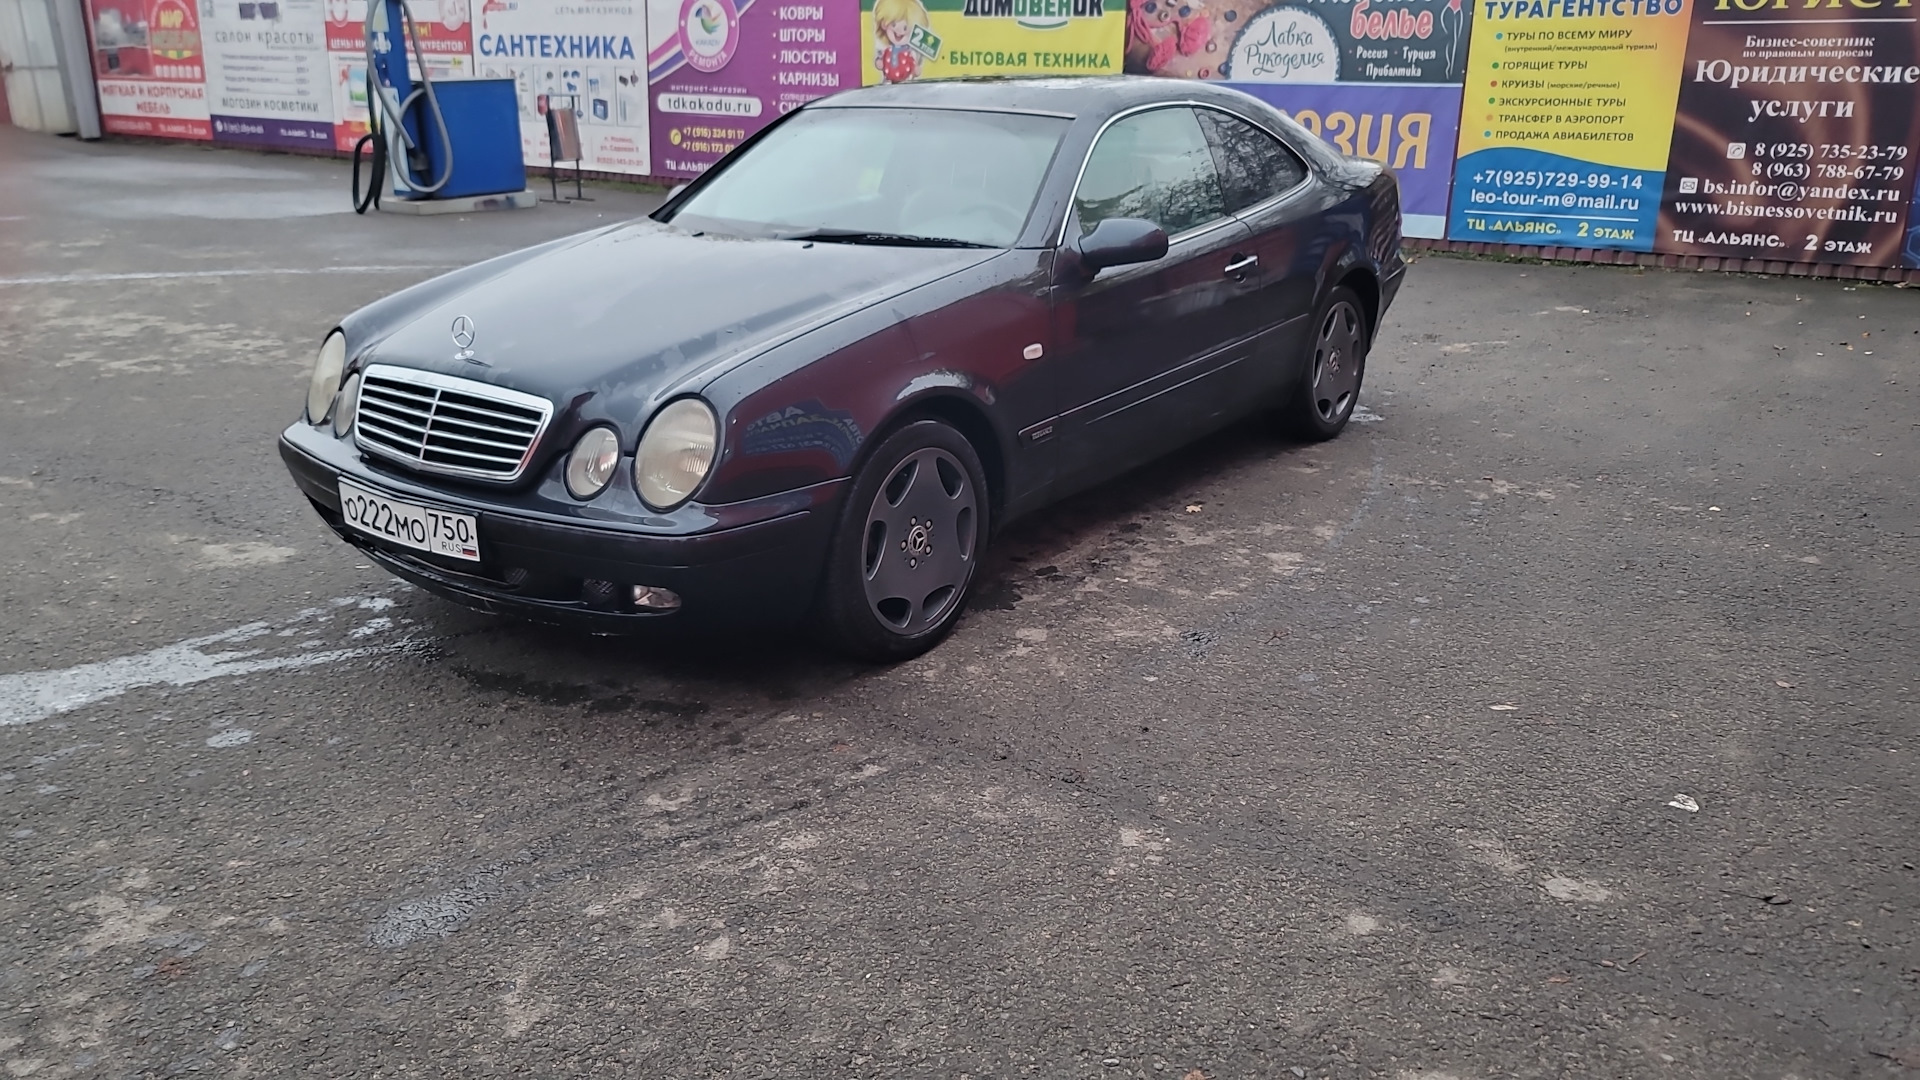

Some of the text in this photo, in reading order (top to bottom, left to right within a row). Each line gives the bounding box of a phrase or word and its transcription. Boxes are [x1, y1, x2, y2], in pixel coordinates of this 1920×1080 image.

[779, 6, 824, 21] КОВРЫ
[963, 0, 1104, 17] ДОМОВЕНОК
[1485, 0, 1684, 20] ТУРАГЕНТСТВО
[1350, 0, 1434, 41] белье
[215, 31, 315, 49] салон красоты
[779, 28, 825, 42] ШТОРЫ
[911, 27, 924, 47] 2
[1257, 21, 1314, 48] Лавка
[1506, 30, 1633, 41] ТУРЫ ПО ВСЕМУ МИРУ
[1745, 35, 1875, 48] Бизнес-советник
[479, 34, 636, 60] САНТЕХНИКА
[1356, 45, 1437, 64] Россия Турция
[1743, 50, 1874, 60] по правовым вопросам
[689, 50, 727, 68] РЕМОНТА
[779, 50, 837, 65] ЛЮСТРЫ
[950, 51, 1111, 69] БЫТОВАЯ ТЕХНИКА
[1244, 43, 1326, 78] Рукоделия
[1502, 61, 1588, 71] ГОРЯЩИЕ ТУРЫ
[779, 71, 840, 87] КАРНИЗЫ
[1365, 62, 1422, 80] Прибалтика
[1693, 60, 1920, 88] Юридические
[1501, 80, 1545, 89] КРУИЗЫ
[264, 100, 319, 113] косметики
[668, 97, 752, 113] tdkakadu.ru
[1499, 98, 1626, 107] ЭКСКУРСИОННЫЕ ТУРЫ
[1748, 99, 1855, 123] услуги
[1499, 114, 1625, 124] ТРАНСФЕР В АЭРОПОРТ
[712, 128, 727, 139] 324
[1495, 130, 1634, 141] ПРОДАЖА АВИАБИЛЕТОВ
[1755, 143, 1908, 160] 8 (925) 735-23-79
[1473, 170, 1643, 189] +7(925)729-99-14
[1751, 162, 1904, 181] 8 (963) 788-67-79
[1471, 189, 1639, 210] leo-tour-m@mail.ru
[1703, 179, 1900, 202] bs.infor@yandex.ru
[1675, 201, 1898, 223] www.bisnessovetnik.ru
[1467, 218, 1486, 231] ТЦ
[1577, 222, 1588, 237] 2
[1594, 228, 1635, 240] ЭТАЖ
[1673, 230, 1694, 243] ТЦ
[1804, 235, 1818, 250] 2
[1824, 240, 1872, 253] ЭТАЖ
[345, 495, 469, 543] О222МО 750
[441, 541, 461, 553] RUS
